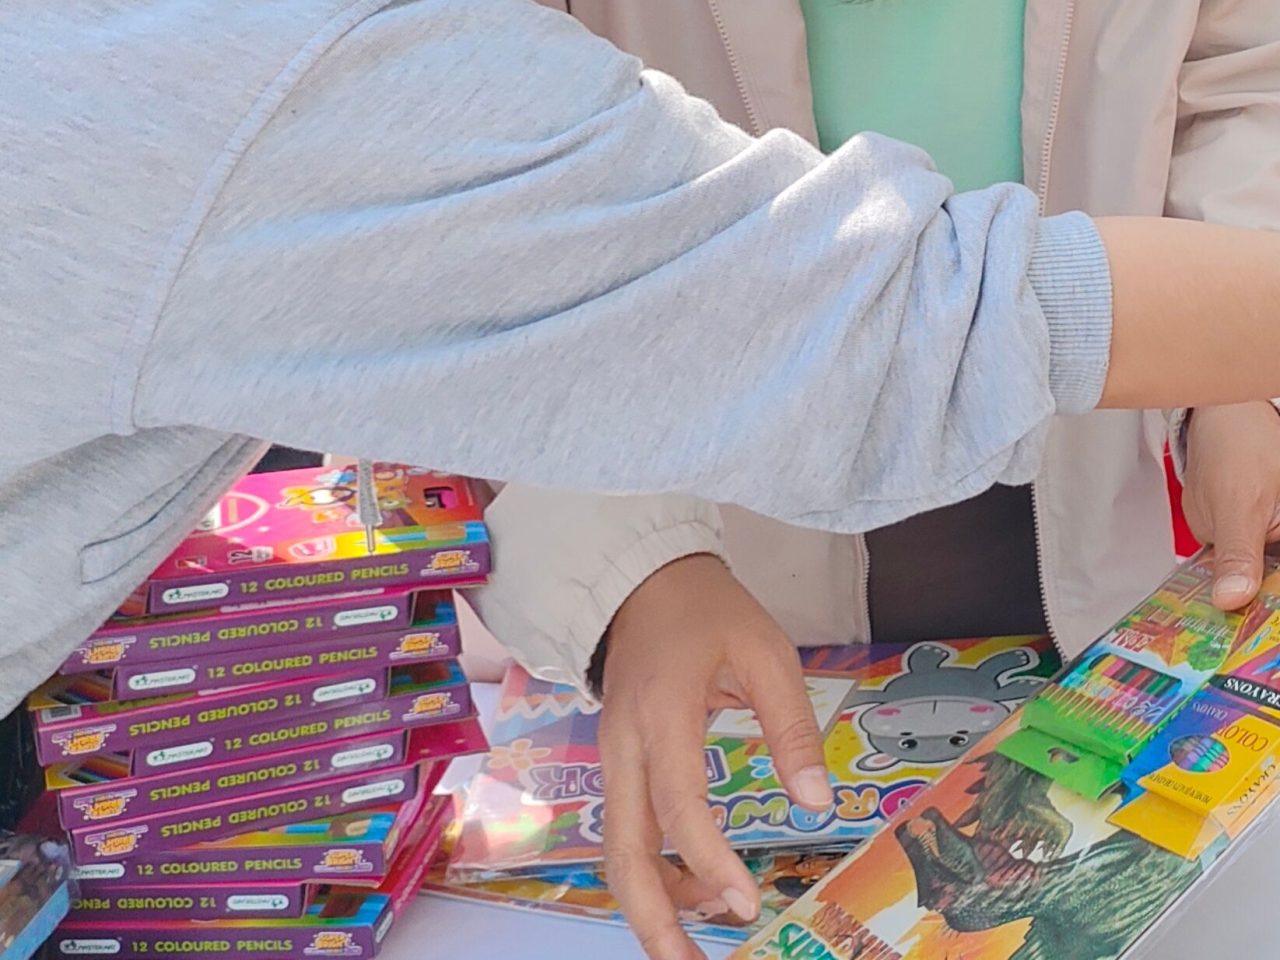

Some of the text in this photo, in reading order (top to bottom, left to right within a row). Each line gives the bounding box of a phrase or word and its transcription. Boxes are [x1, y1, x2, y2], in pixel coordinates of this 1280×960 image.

[240, 563, 409, 593] 12 COLOURED PENCILS
[149, 617, 322, 649] 12 COLOURED PENCILS
[207, 646, 378, 679] 12 COLOURED PENCILS
[128, 694, 302, 736] 12 COLOURED PENCILS
[224, 709, 391, 750] 12 COLOURED PENCILS
[149, 759, 320, 801] 12 COLOURED PENCILS
[160, 794, 331, 837] 12 COLOURED PENCILS
[137, 858, 303, 876] 12 COLOURED PENCILS
[71, 896, 216, 910] 12 COLOURED PENC
[132, 939, 293, 953] 12 COLOURED PENCILS
